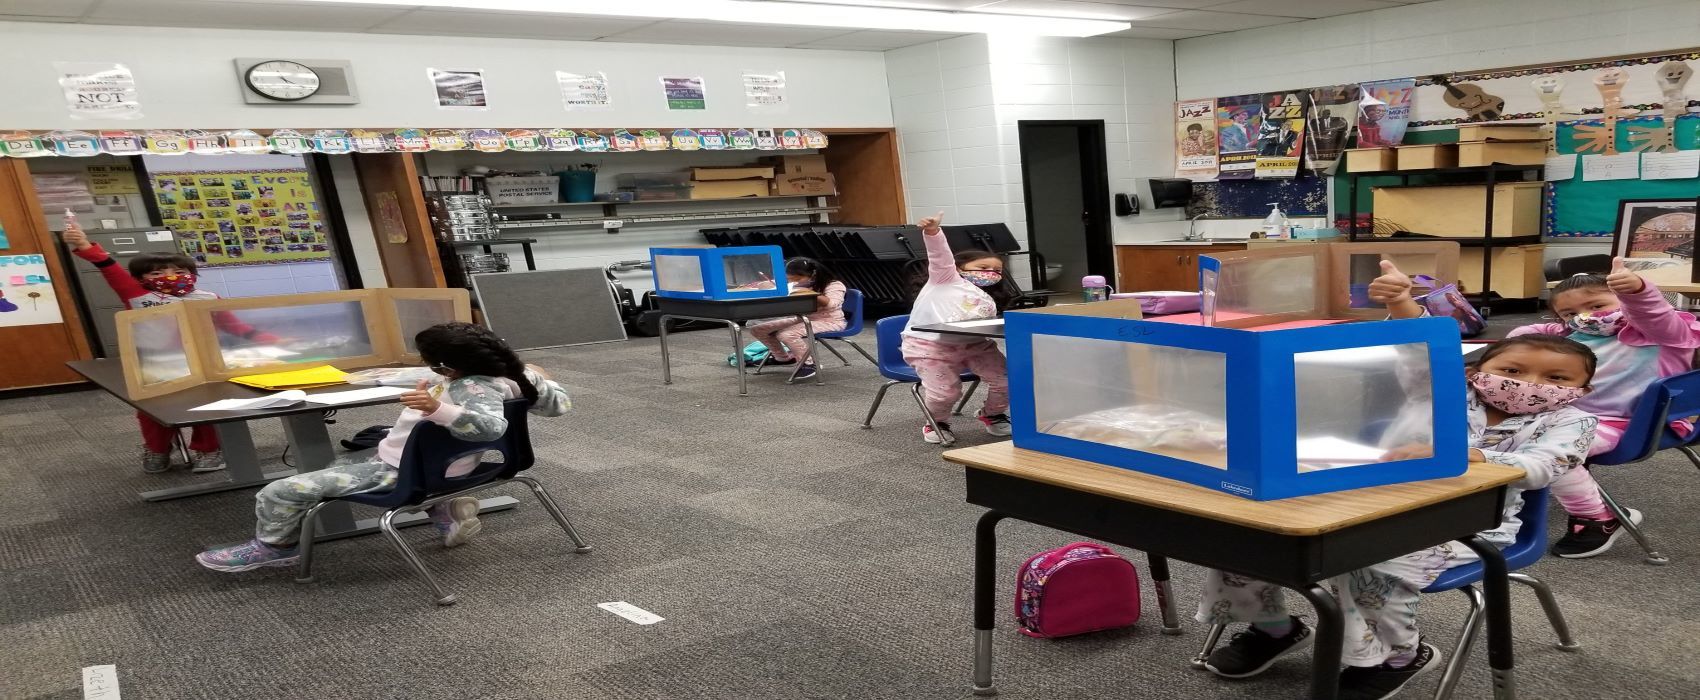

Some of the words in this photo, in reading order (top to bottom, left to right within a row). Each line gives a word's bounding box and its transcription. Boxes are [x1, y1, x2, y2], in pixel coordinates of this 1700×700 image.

[77, 92, 125, 103] NOT
[1179, 106, 1212, 118] JAZZ
[251, 175, 311, 187] Every
